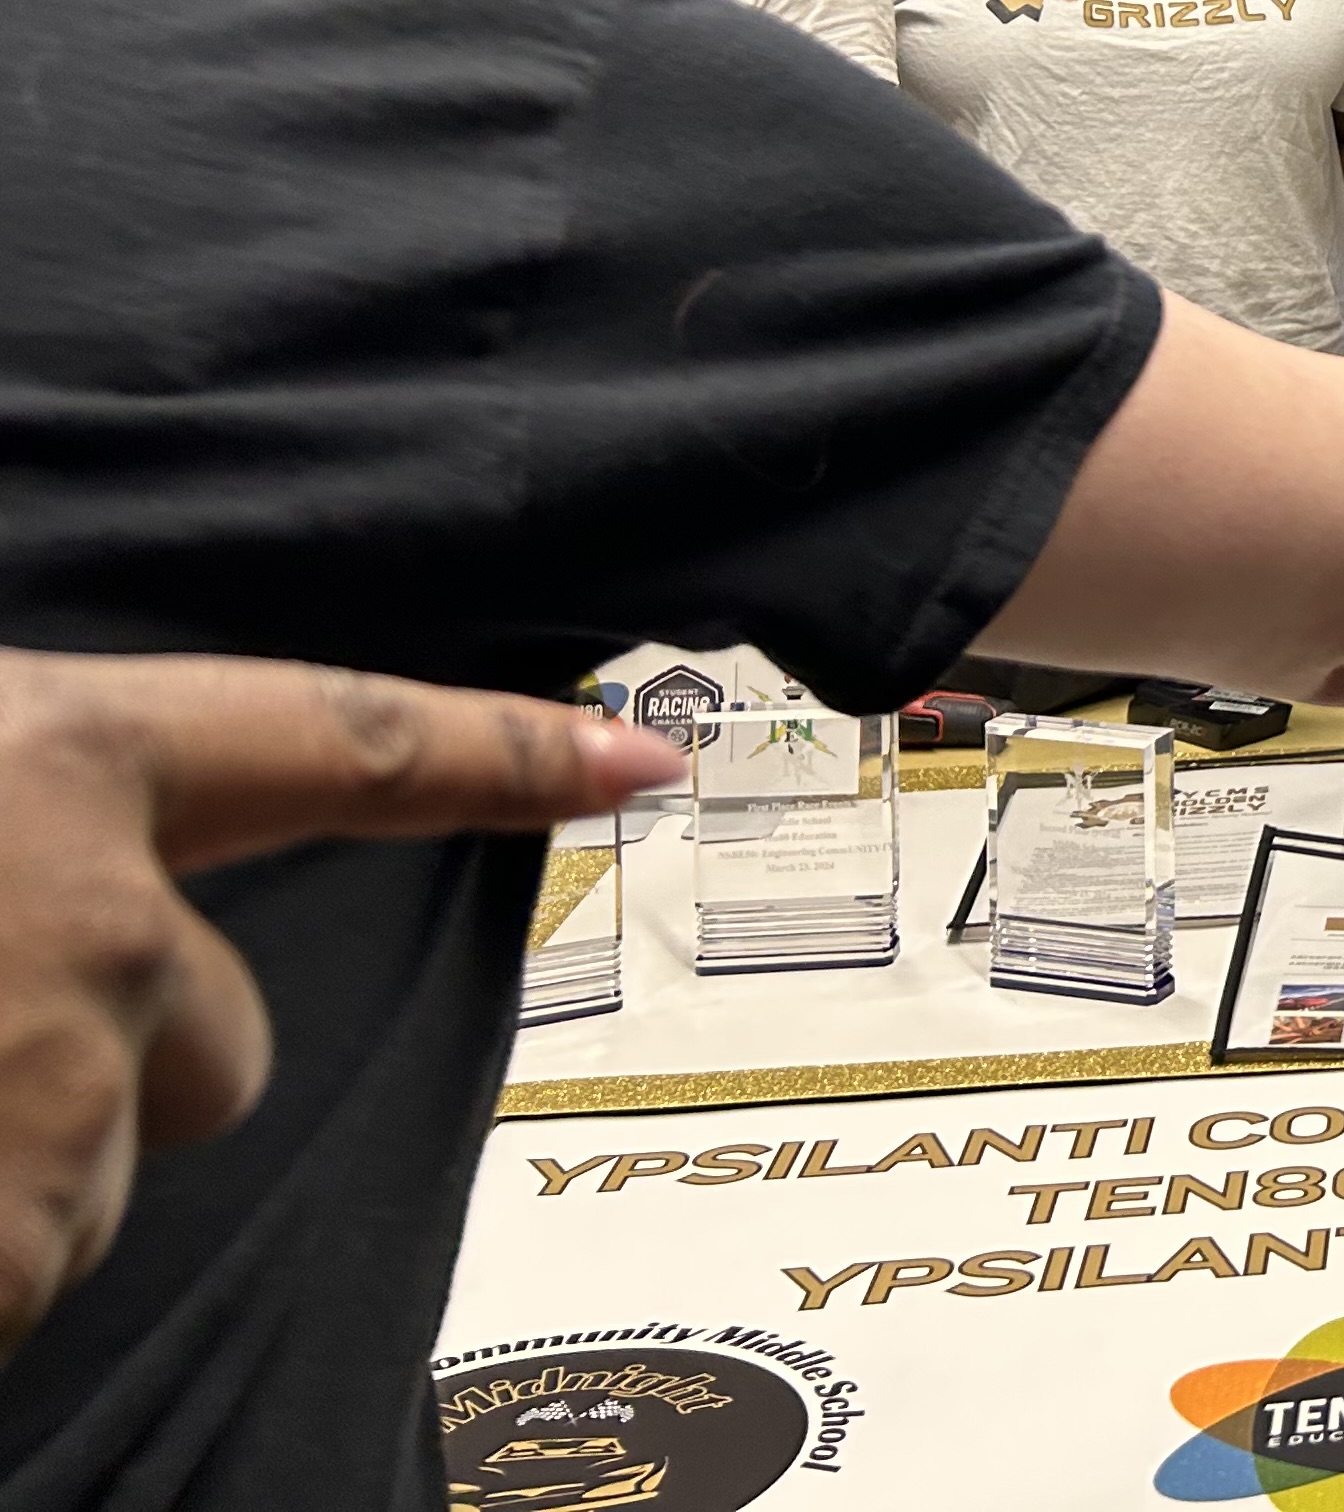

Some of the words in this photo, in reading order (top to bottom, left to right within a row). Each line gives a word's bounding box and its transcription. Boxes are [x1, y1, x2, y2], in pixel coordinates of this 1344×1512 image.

[651, 718, 693, 727] CHALLEN
[527, 1116, 1156, 1197] YPSILANTI
[430, 1322, 707, 1368] ommunity
[703, 1324, 837, 1383] Middle
[801, 1378, 866, 1474] School
[440, 1363, 734, 1434] Midnight
